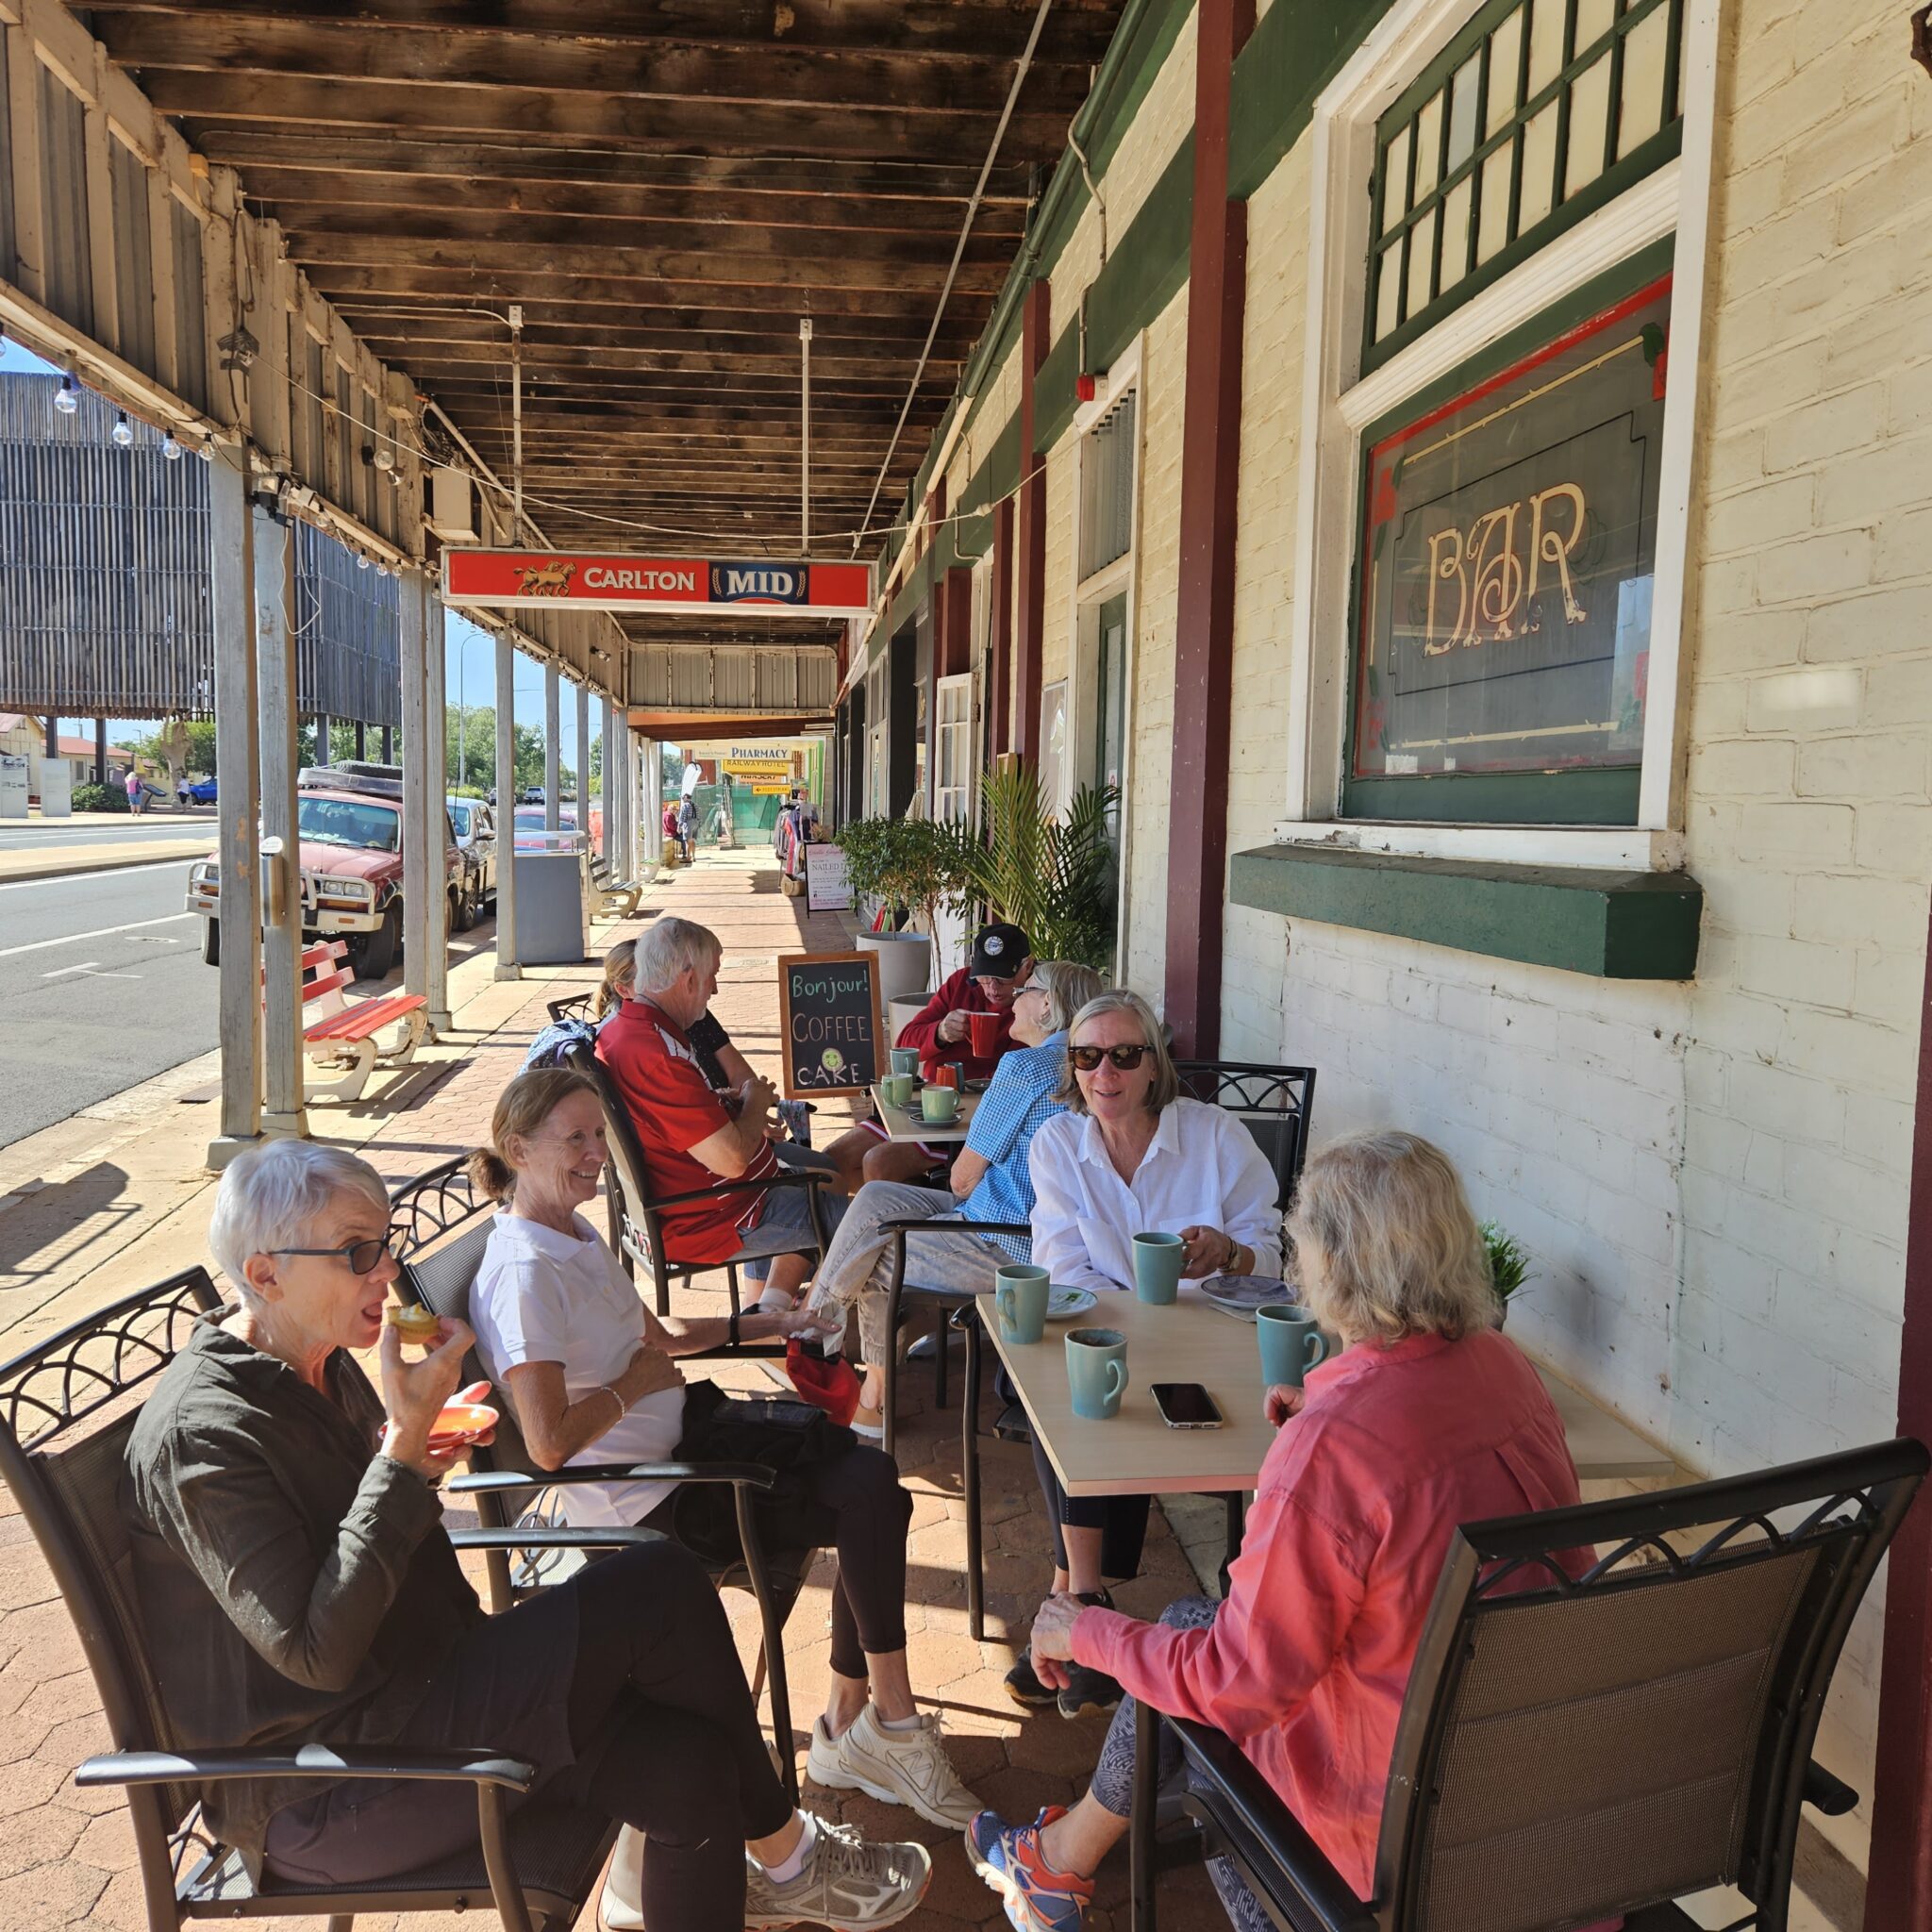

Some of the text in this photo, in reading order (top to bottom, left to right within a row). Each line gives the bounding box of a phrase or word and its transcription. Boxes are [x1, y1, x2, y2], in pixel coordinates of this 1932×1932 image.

[584, 567, 793, 596] CARLTON MID
[1422, 482, 1587, 658] BAR
[731, 747, 788, 758] PHARMACY
[811, 862, 840, 871] NAILED
[791, 969, 869, 1004] Bonjour!
[791, 1012, 871, 1043] COFFEE
[796, 1063, 861, 1086] CAKE
